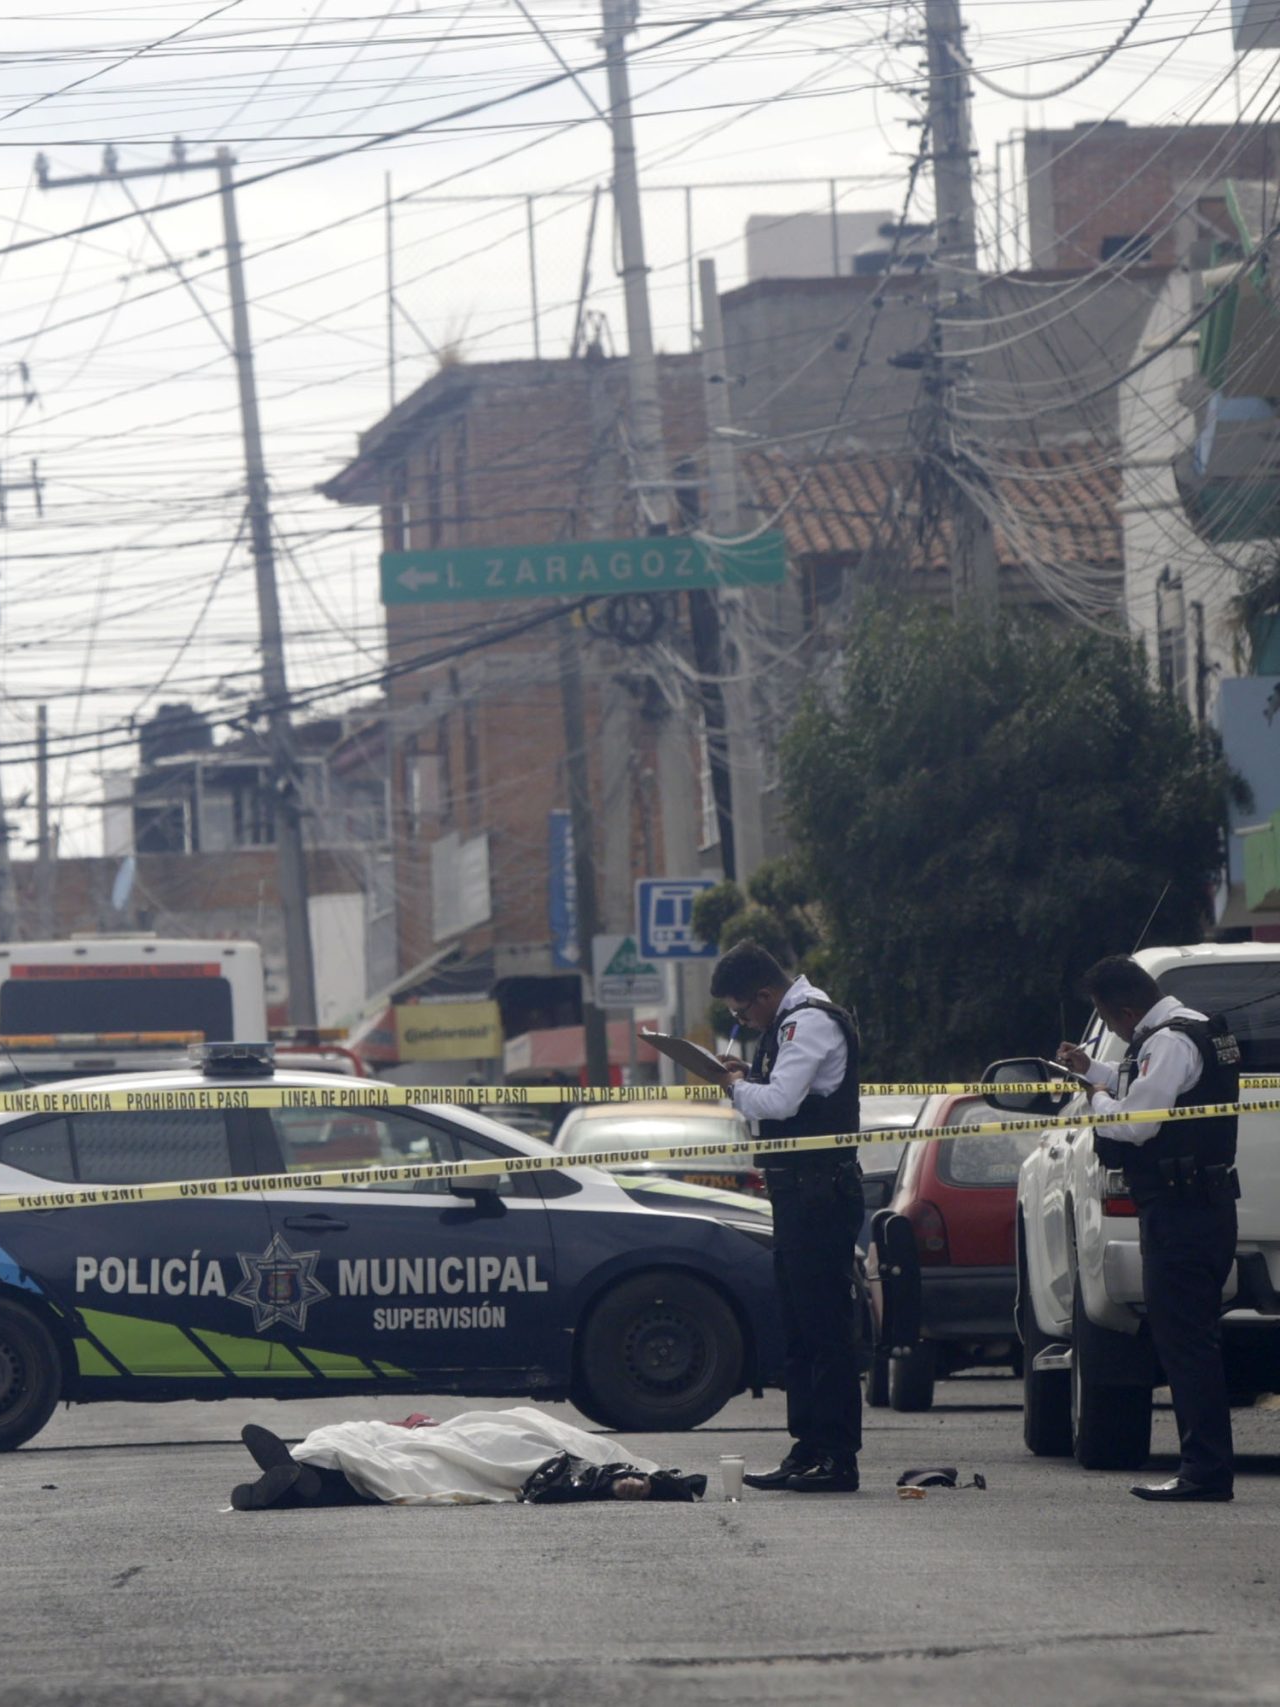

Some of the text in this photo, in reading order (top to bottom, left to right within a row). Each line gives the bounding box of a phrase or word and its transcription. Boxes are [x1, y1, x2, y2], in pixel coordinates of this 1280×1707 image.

[446, 561, 462, 588] I.
[4, 1094, 40, 1111] LINEA
[44, 1094, 58, 1111] DE
[63, 1093, 112, 1110] POLICIA
[127, 1092, 196, 1110] PROHIBIDO
[199, 1091, 213, 1109] EL
[217, 1090, 249, 1109] PASO
[281, 1091, 317, 1107] LINEA
[321, 1090, 335, 1107] DE
[340, 1089, 390, 1106] POLICIA
[405, 1088, 474, 1105] PROHIBIDO
[477, 1088, 491, 1104] EL
[496, 1087, 528, 1104] PASO
[560, 1087, 596, 1102] LINEA
[600, 1087, 614, 1102] DE
[619, 1086, 668, 1101] POLICIA
[75, 1250, 549, 1297] POLICÍA MUNICIPAL
[372, 1301, 506, 1330] SUPERVISIÓN
